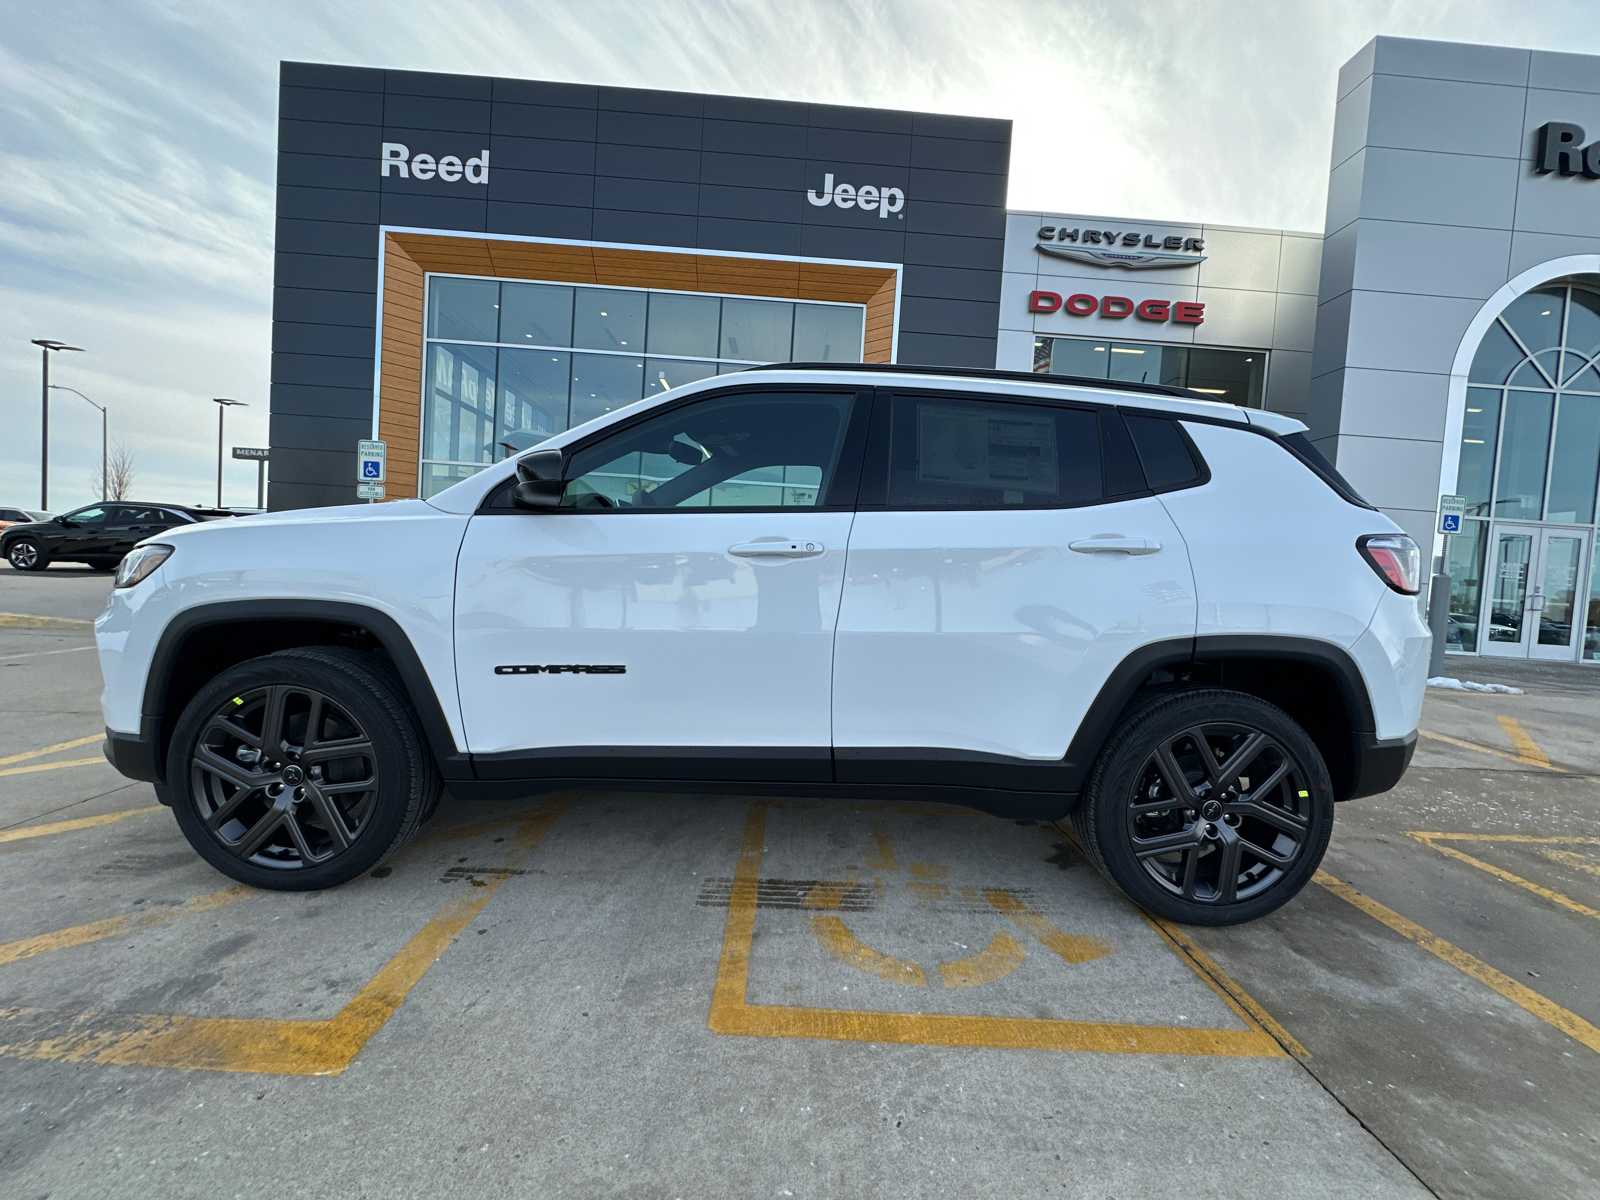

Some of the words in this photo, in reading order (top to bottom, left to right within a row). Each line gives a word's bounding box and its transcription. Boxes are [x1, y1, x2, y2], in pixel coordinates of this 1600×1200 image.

[381, 142, 489, 184] Reed
[807, 173, 905, 219] Jeep
[1039, 226, 1205, 251] CHRYSLER
[1029, 290, 1206, 327] DODGE
[360, 450, 384, 458] PARKING
[361, 443, 384, 451] RESERVED
[494, 664, 627, 676] COMPASS
